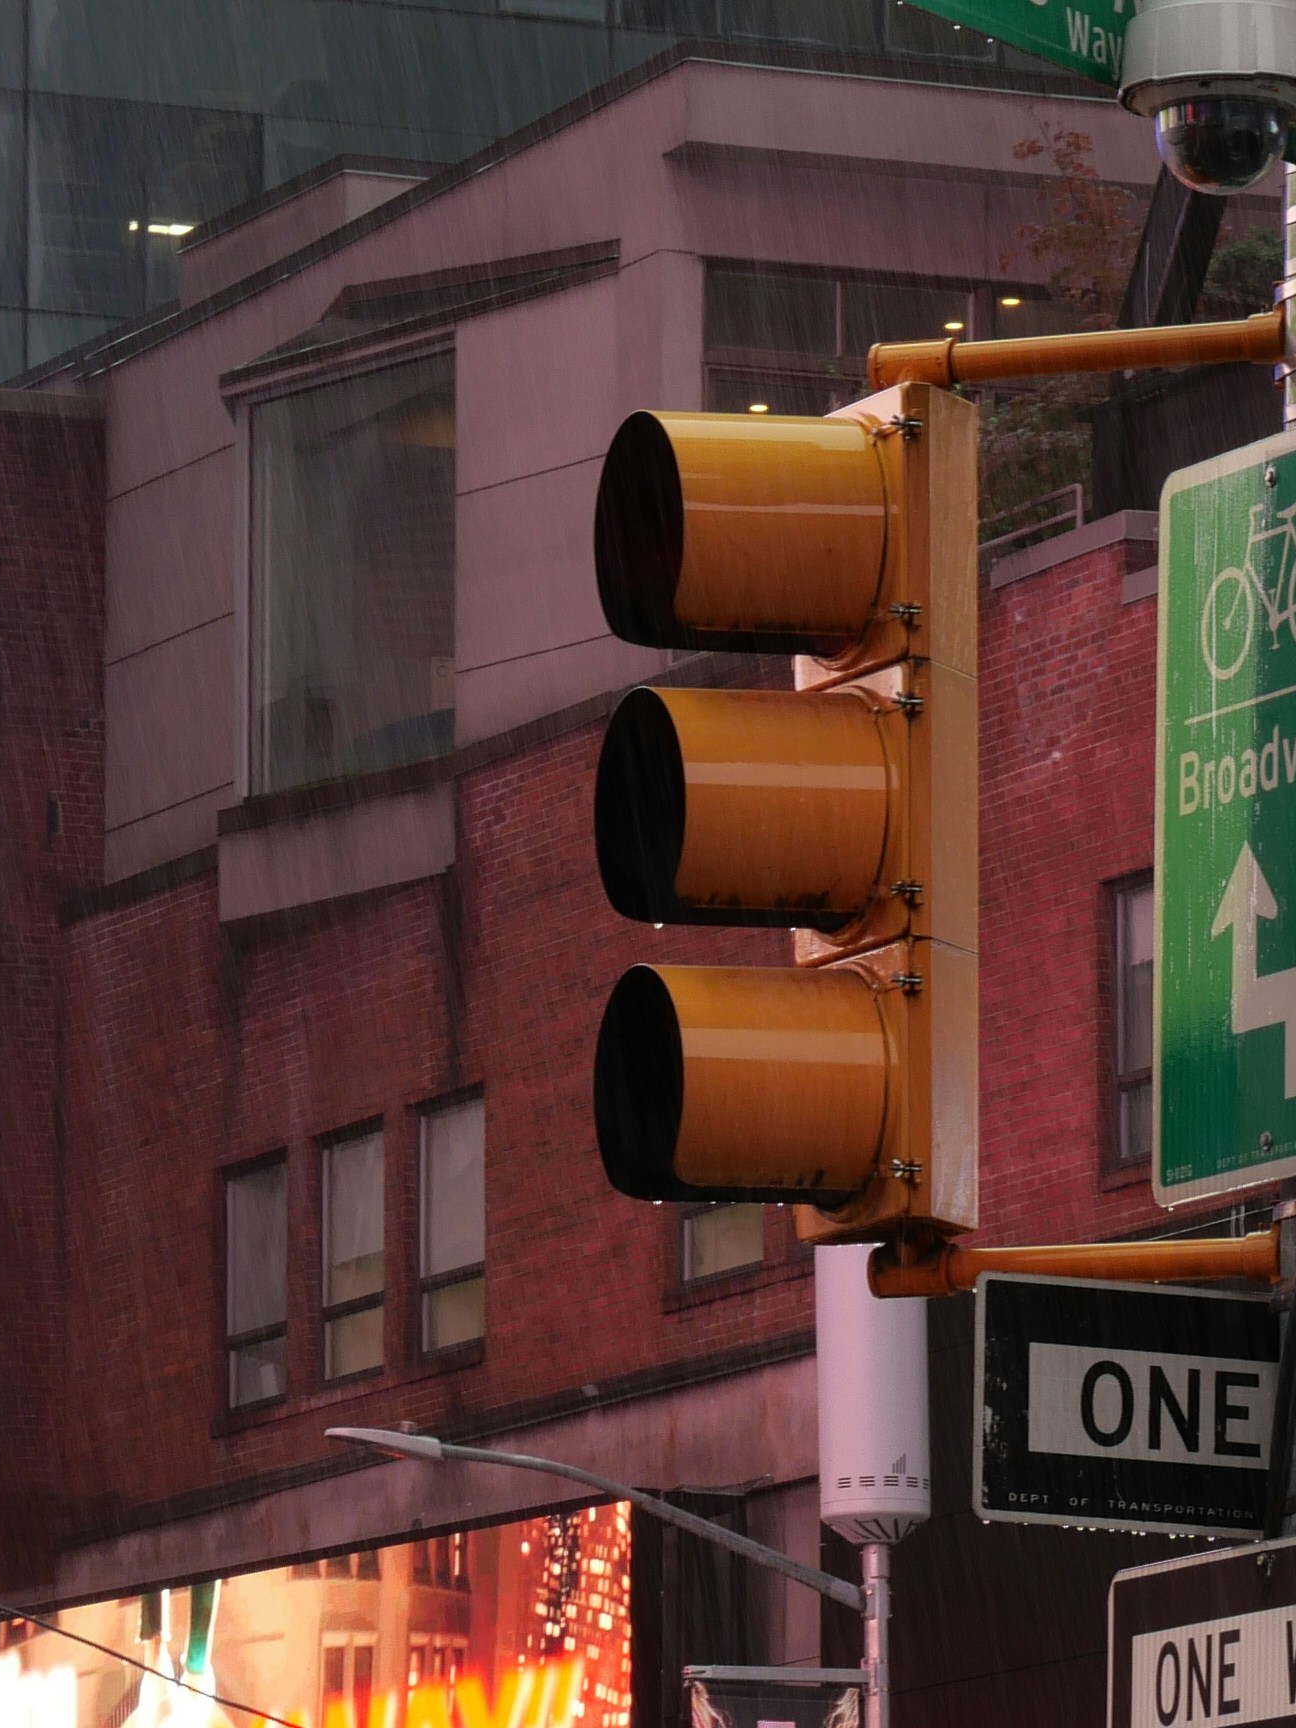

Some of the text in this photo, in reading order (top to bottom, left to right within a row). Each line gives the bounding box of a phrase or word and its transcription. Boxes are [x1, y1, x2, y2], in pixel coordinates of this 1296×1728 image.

[1065, 6, 1123, 82] Way
[1079, 1359, 1262, 1459] ONE
[1008, 1492, 1255, 1520] DEPT OF TRANSPORTATION
[1155, 1627, 1242, 1728] ONE
